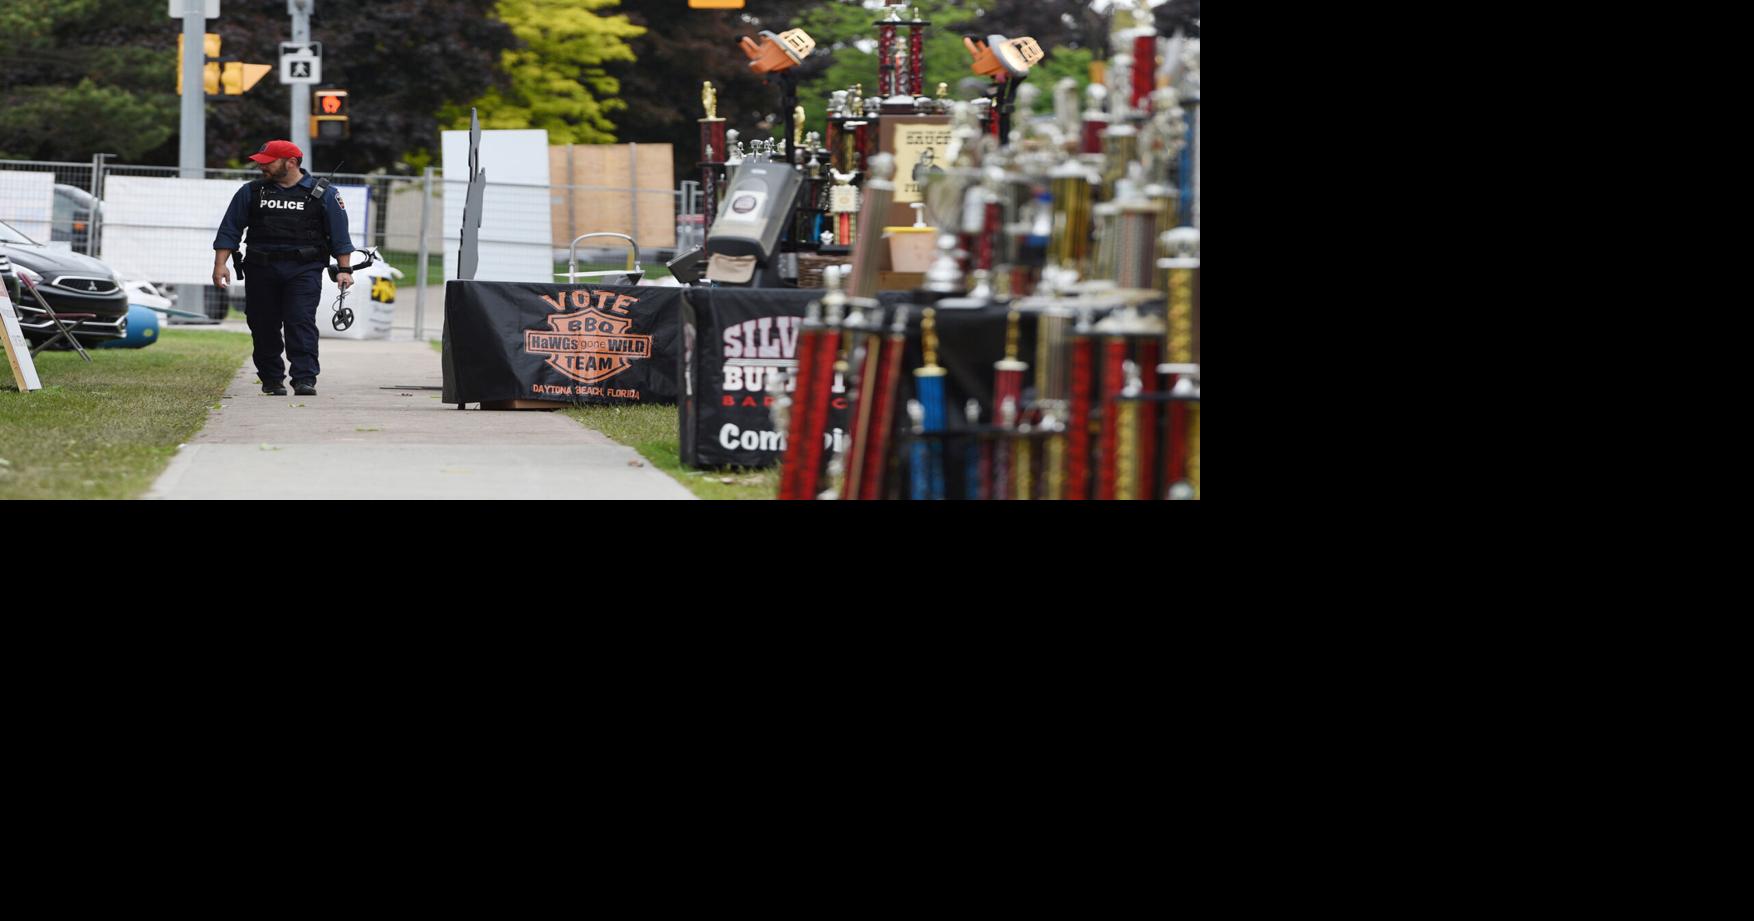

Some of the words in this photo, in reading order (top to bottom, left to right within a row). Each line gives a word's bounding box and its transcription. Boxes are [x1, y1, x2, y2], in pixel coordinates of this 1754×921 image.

[260, 199, 305, 211] POLICE
[539, 289, 640, 315] VOTE
[567, 317, 615, 334] BBQ
[580, 339, 606, 351] gone
[722, 316, 807, 358] SILV
[564, 355, 613, 371] TEAM
[532, 384, 573, 396] DAYTONA
[607, 388, 640, 400] FLORIDA
[719, 422, 789, 452] Com
